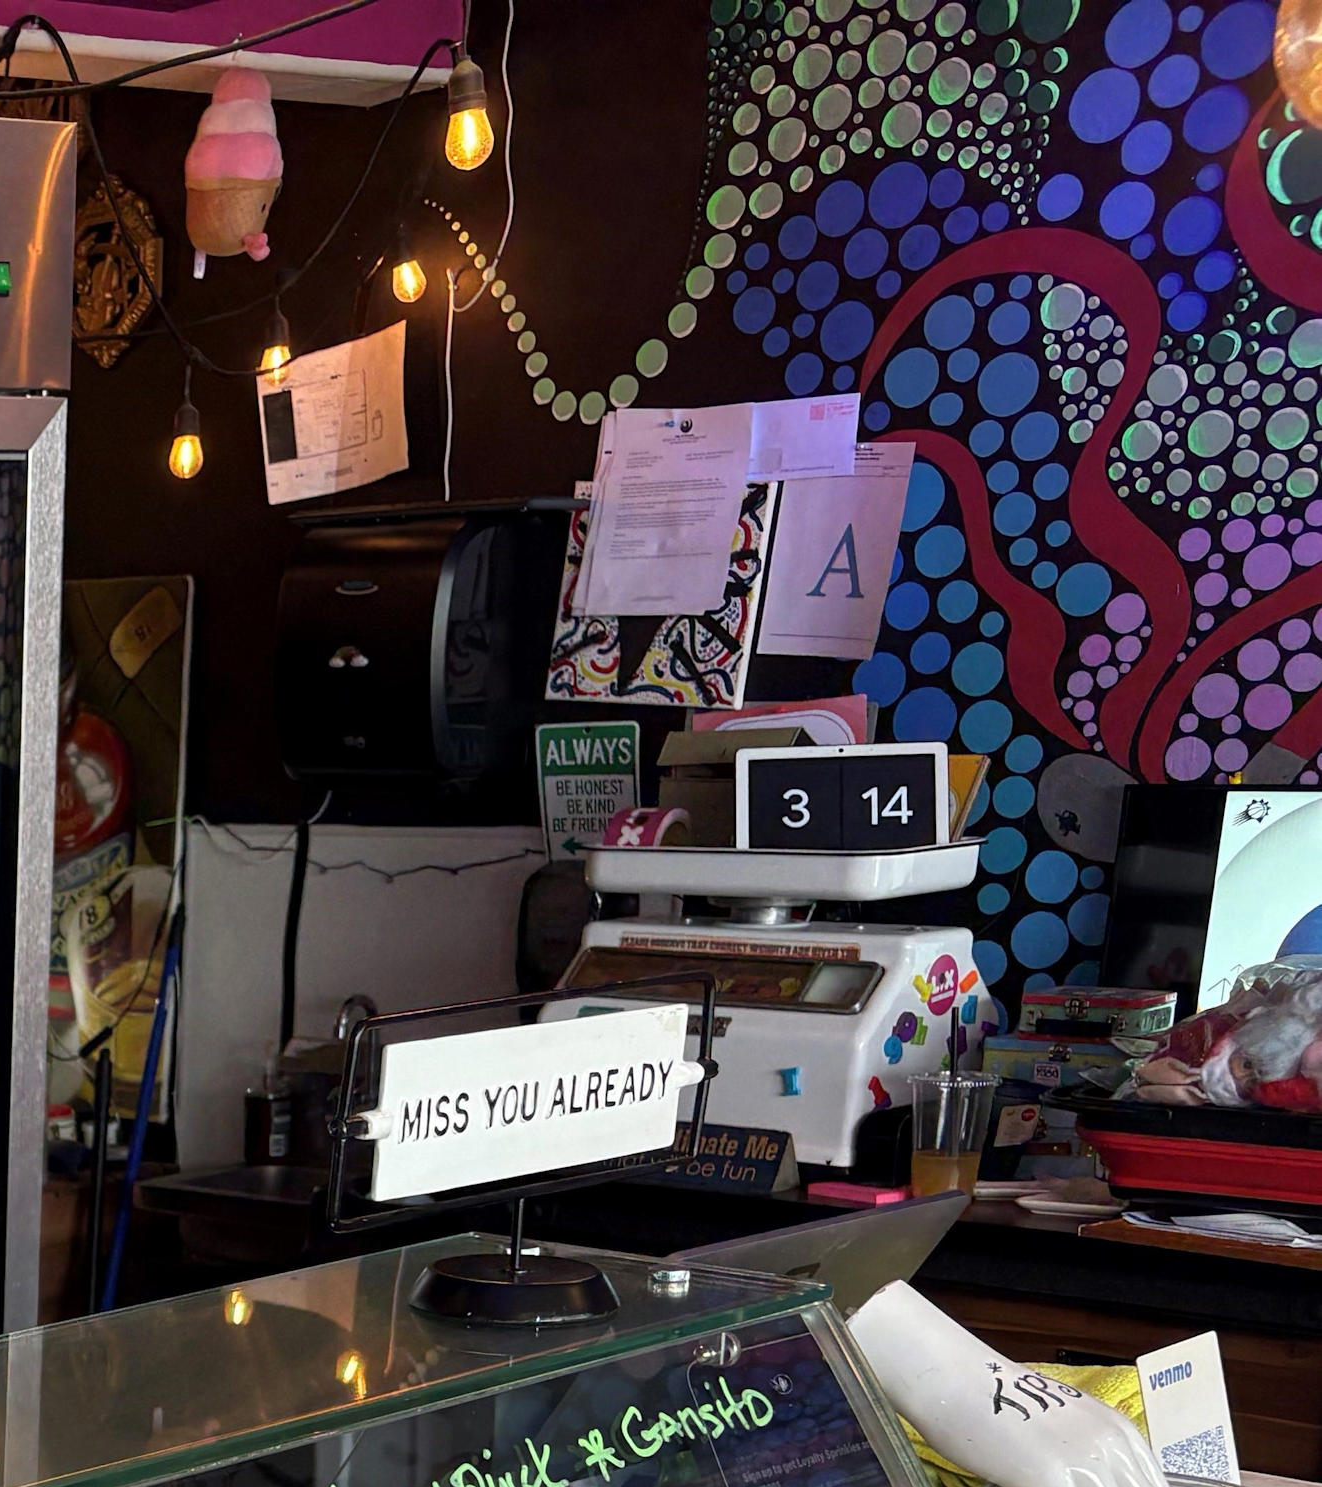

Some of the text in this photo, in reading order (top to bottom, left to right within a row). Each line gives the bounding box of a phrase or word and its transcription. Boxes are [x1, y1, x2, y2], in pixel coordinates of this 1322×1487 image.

[805, 522, 865, 599] A
[545, 737, 633, 767] ALWAYS
[556, 779, 625, 796] BE HONEST
[567, 798, 616, 815] BE KIND
[781, 785, 914, 829] 3 14
[552, 817, 608, 833] BE FRIEN
[399, 1060, 674, 1143] MISS YOU ALREADY
[743, 1134, 780, 1161] Me
[685, 1159, 756, 1181] be fun
[1148, 1360, 1193, 1392] venmo
